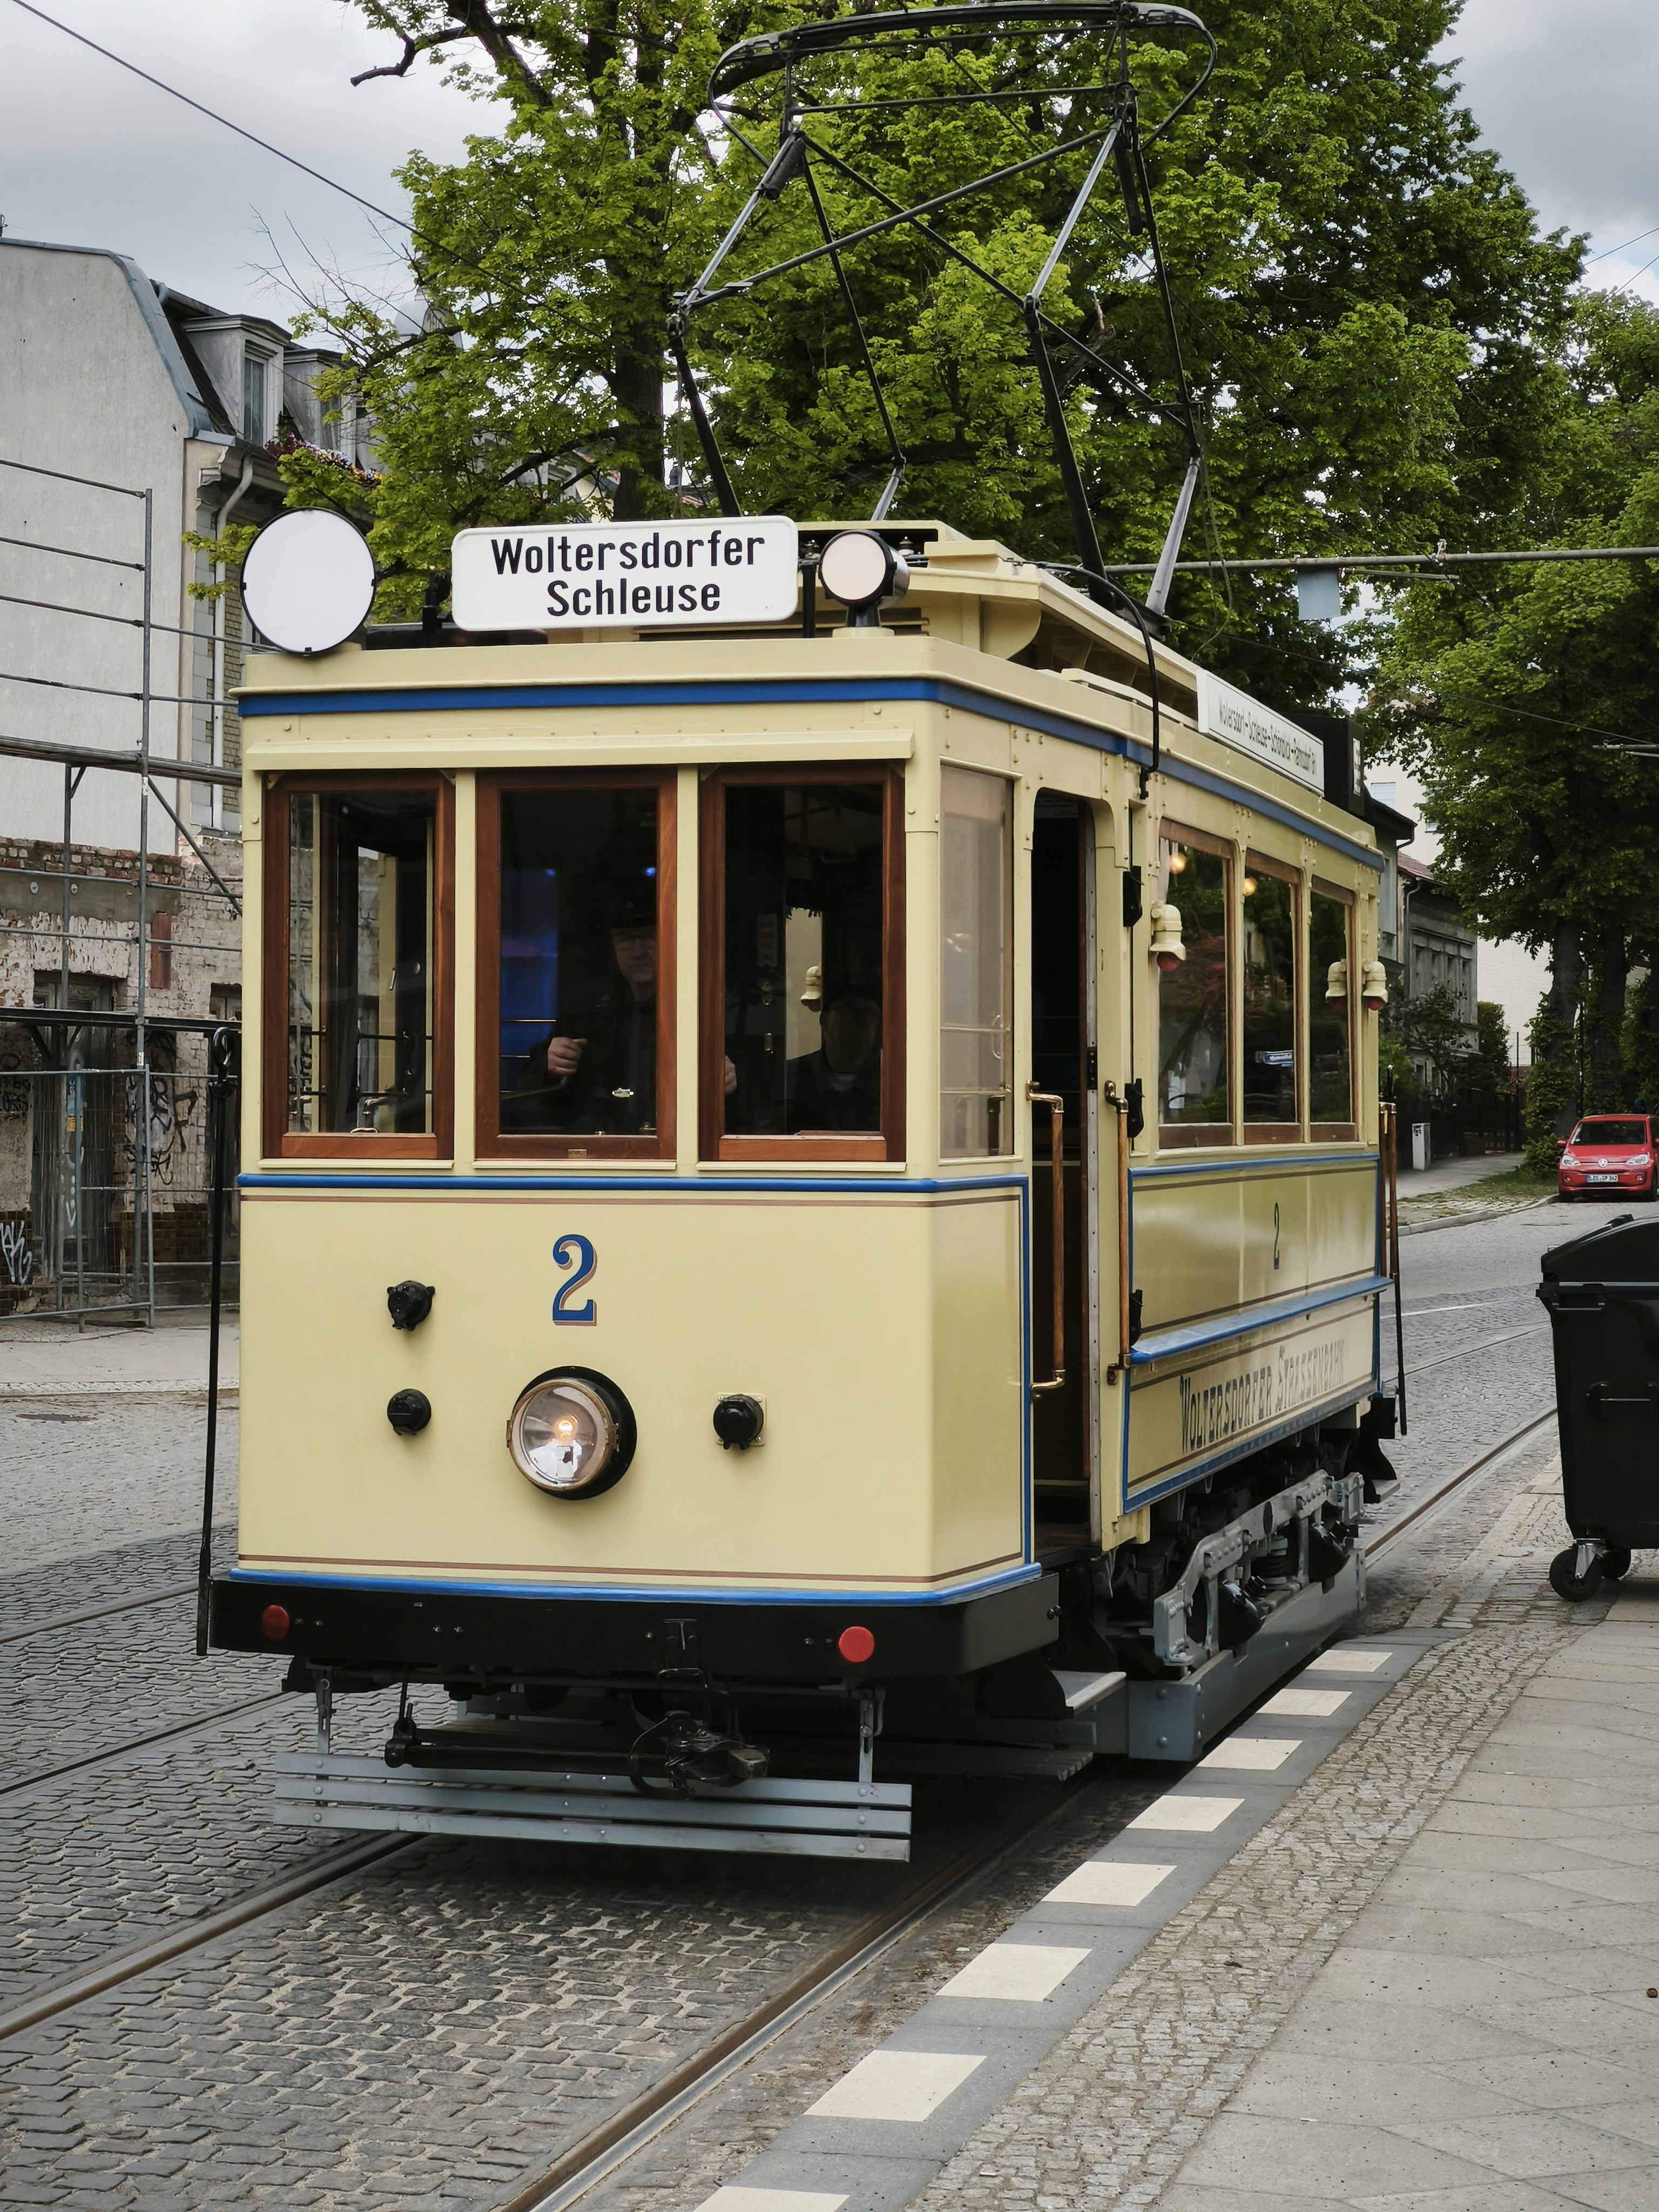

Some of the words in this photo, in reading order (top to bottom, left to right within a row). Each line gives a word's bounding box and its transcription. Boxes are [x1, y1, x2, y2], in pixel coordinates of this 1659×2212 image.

[491, 530, 765, 575] Woltersdorfer
[547, 578, 720, 617] Schleuse
[1274, 1202, 1279, 1270] 2
[552, 1234, 597, 1326] 2
